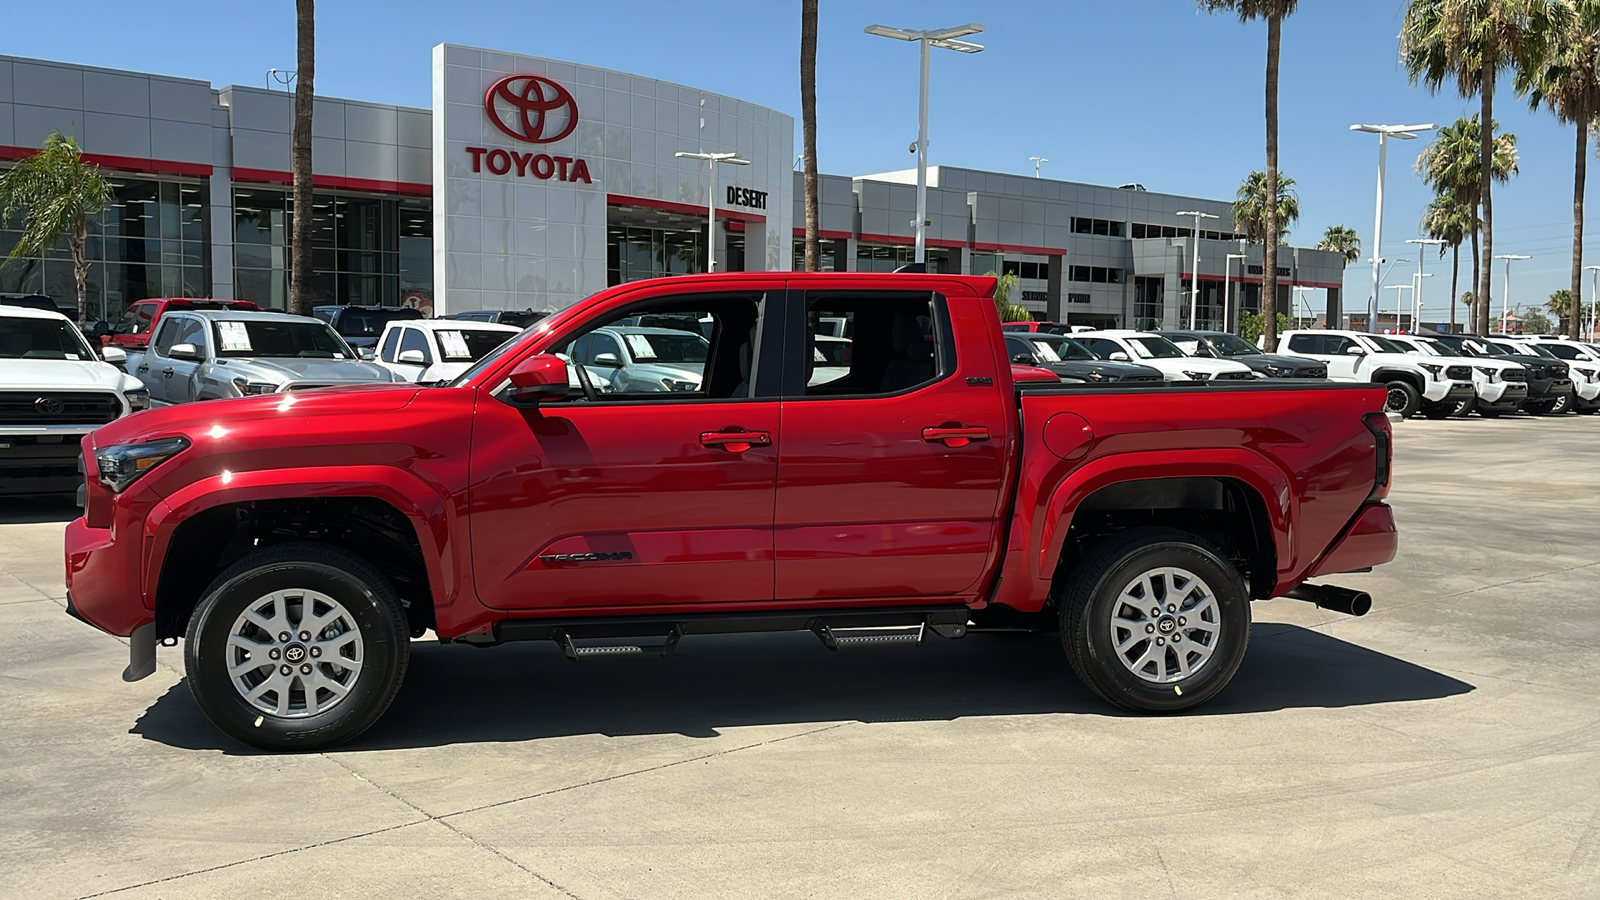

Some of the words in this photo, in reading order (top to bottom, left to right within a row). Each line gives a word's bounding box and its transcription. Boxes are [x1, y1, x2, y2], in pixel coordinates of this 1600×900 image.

[465, 146, 593, 184] TOYOTA
[727, 185, 769, 210] DESERT
[1022, 291, 1048, 302] SERVIC
[539, 551, 633, 563] TACOMA
